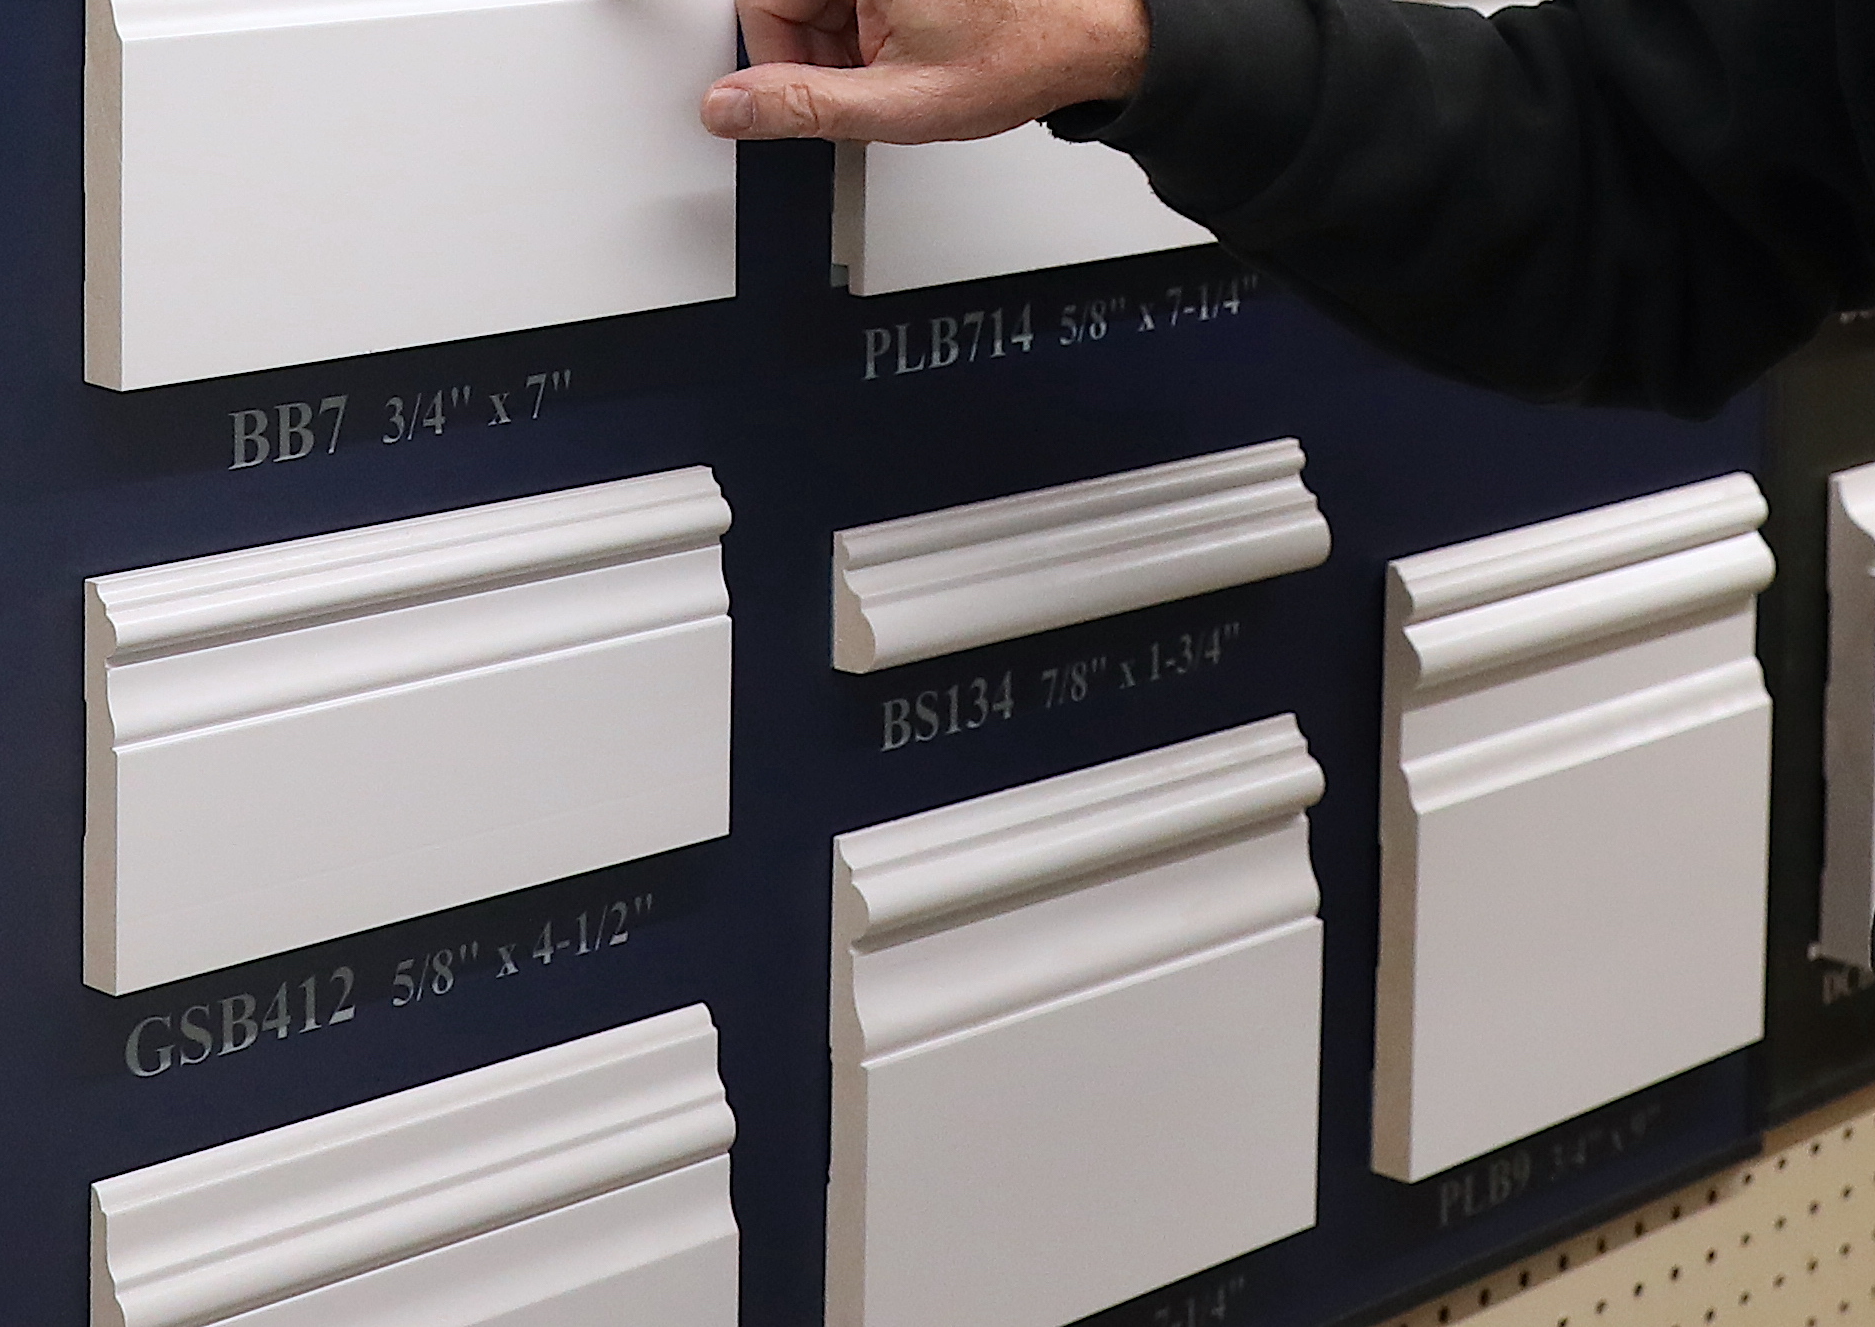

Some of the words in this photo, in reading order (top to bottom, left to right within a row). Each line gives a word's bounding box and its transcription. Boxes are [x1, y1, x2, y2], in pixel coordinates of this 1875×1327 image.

[864, 305, 1035, 380] PLB714
[1059, 298, 1124, 346] 5/8"
[1139, 302, 1155, 332] x
[1167, 275, 1259, 328] 7-1/4"
[228, 394, 348, 471] BB7
[382, 385, 471, 444] 3/4"
[488, 391, 511, 426] x
[526, 369, 572, 420] 7"
[880, 671, 1014, 752] BS134
[1041, 657, 1107, 709] 7/8"
[1119, 661, 1136, 689] x
[1150, 622, 1241, 682] 1-3/4"
[125, 965, 356, 1078] GSB412
[392, 941, 479, 1008] 5/8"
[496, 943, 518, 979] x
[532, 893, 654, 965] 4-1/2"
